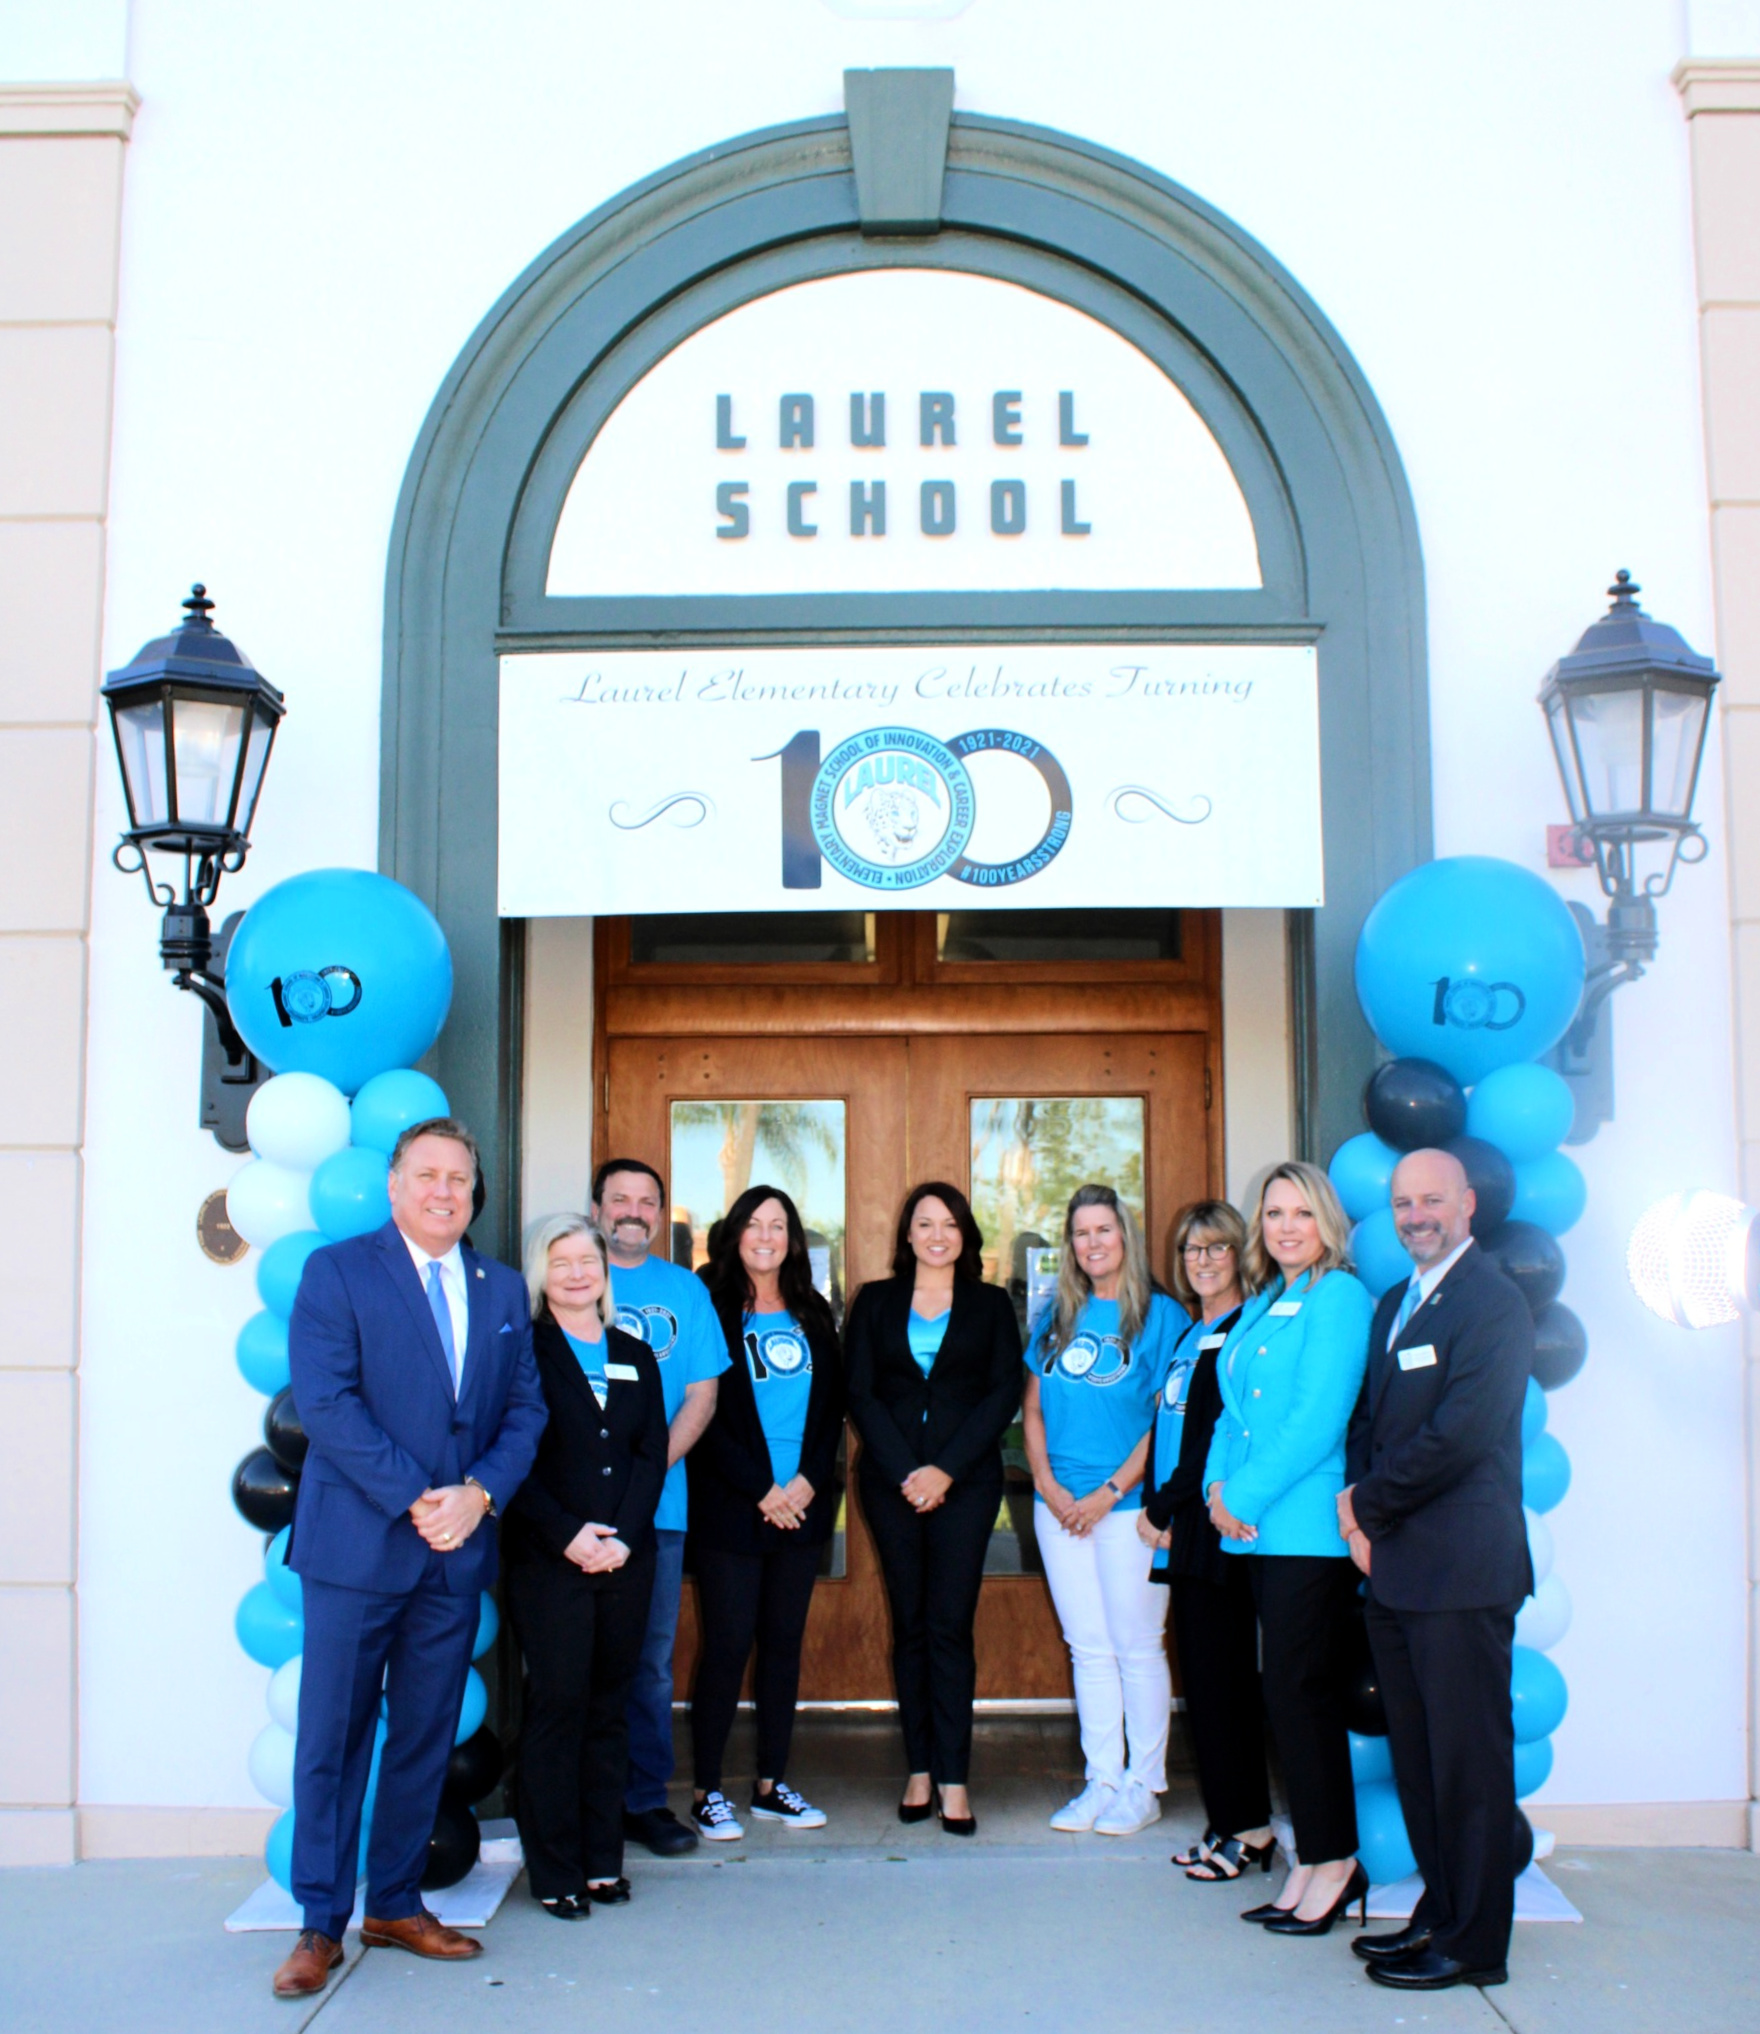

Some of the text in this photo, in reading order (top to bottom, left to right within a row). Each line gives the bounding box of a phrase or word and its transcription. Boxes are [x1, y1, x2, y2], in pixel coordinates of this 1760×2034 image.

[716, 391, 1089, 449] LAUREL
[716, 479, 1092, 538] SCHOOL
[559, 665, 1254, 708] Laurel Elementary Celebrates Turning
[959, 732, 1040, 759] 1921-2021
[750, 727, 1073, 891] 100
[815, 732, 969, 884] ELEMENTARY MAGNET SCHOOL OF INNOVATION & CAREER EXPLORATION
[844, 755, 941, 810] LAUREL
[960, 810, 1071, 884] #100YEARSSTRONG
[264, 965, 363, 1028] 100
[1427, 976, 1527, 1031] 100
